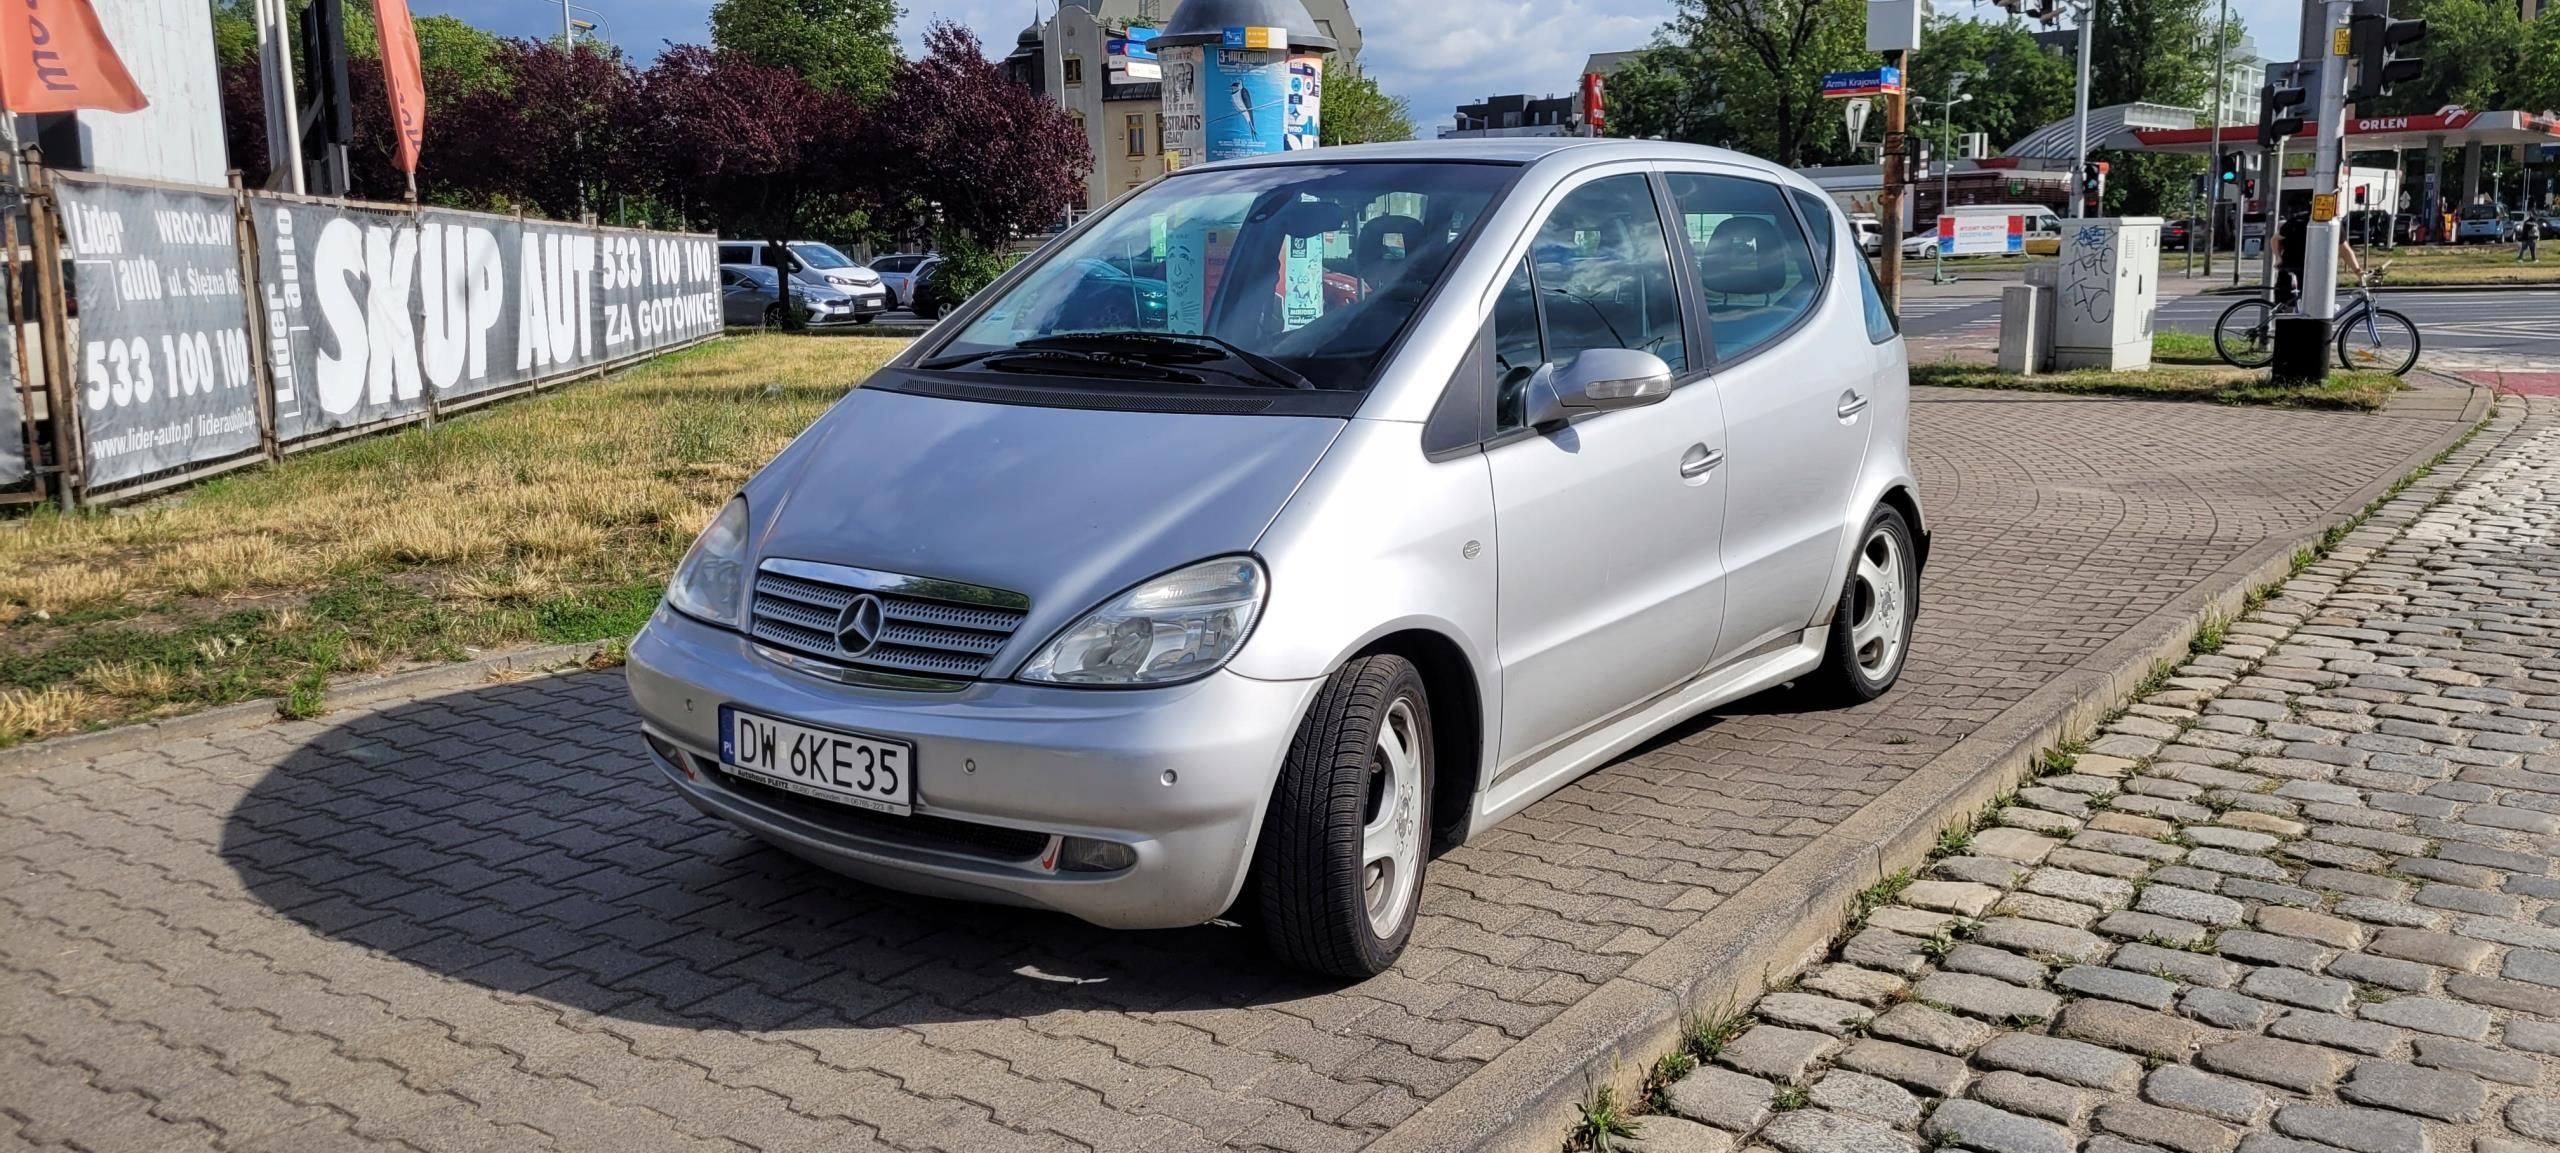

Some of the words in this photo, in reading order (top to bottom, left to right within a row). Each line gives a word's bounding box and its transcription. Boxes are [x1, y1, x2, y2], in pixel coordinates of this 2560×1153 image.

[26, 0, 80, 91] mo
[2359, 118, 2408, 131] ORLEN
[71, 200, 124, 254] Lider
[118, 254, 162, 300] auto
[167, 267, 187, 297] ul.
[187, 260, 226, 303] Ślężna
[225, 267, 239, 295] 86
[276, 208, 302, 309] auto
[602, 236, 643, 290] 533
[648, 238, 681, 286] 100
[684, 240, 711, 283] 100
[268, 283, 295, 403] Lider
[314, 217, 503, 415] SKUP
[517, 232, 595, 371] AUT
[604, 303, 635, 347] ZA
[638, 288, 715, 337] GOTÓWKĘ
[87, 335, 154, 411] 533
[162, 330, 214, 398] 100
[216, 327, 249, 389] 100
[92, 416, 194, 460] www.lider-auto.pl
[723, 741, 734, 755] PL
[740, 718, 777, 770] DW
[790, 733, 899, 796] 6KE35
